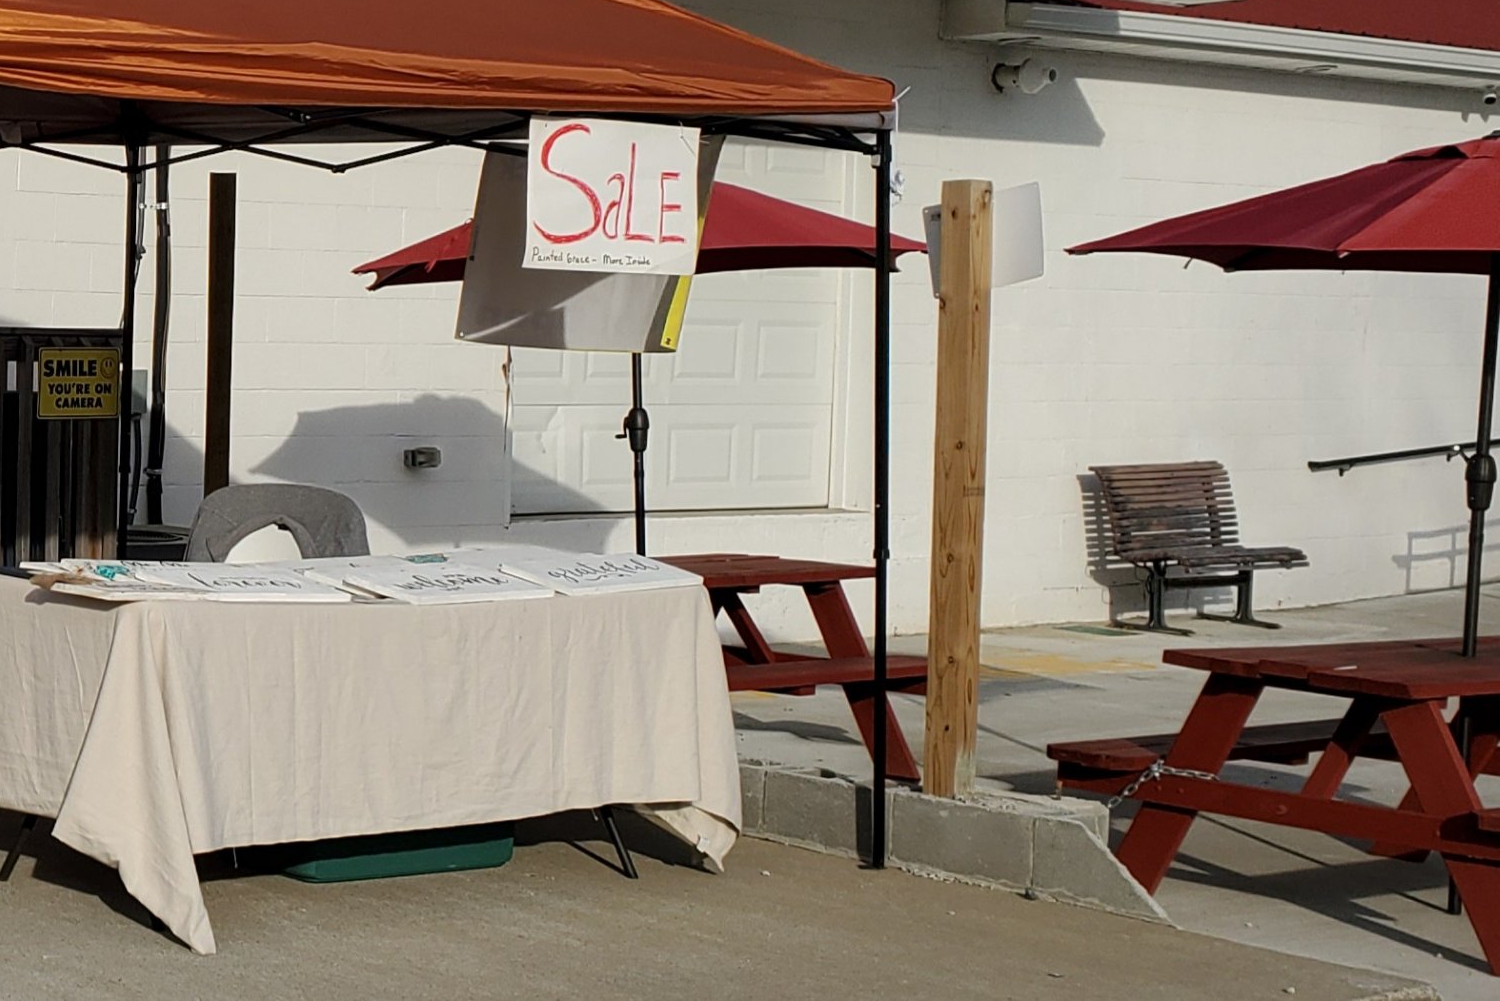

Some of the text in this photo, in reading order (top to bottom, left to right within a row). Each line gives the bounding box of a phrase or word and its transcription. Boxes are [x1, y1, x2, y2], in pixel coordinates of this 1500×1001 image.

[532, 246, 563, 262] Painted
[603, 254, 623, 265] More
[43, 359, 97, 377] SMILE
[48, 382, 112, 395] YOU'RE ON
[55, 396, 103, 409] CAMERA
[394, 574, 509, 589] welcome
